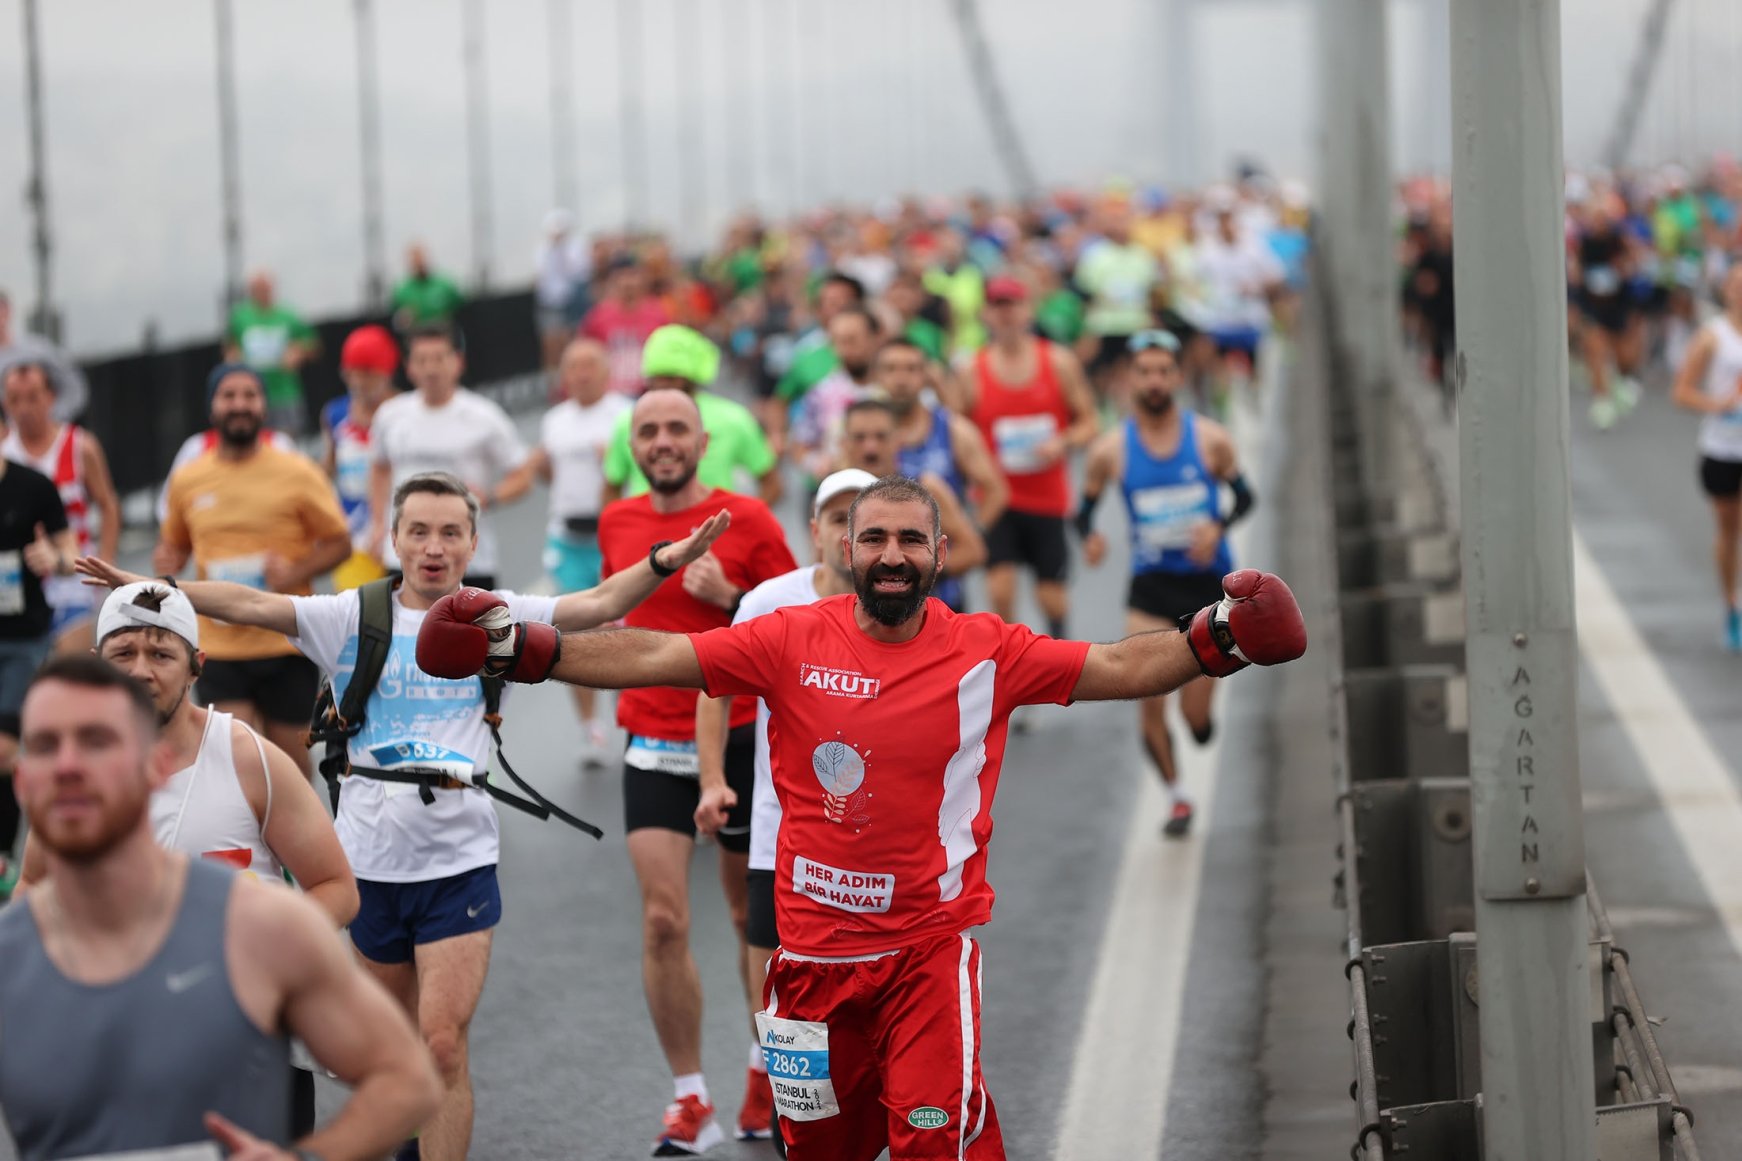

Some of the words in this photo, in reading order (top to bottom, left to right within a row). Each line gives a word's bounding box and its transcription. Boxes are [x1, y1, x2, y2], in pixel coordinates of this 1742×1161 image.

[804, 670, 876, 695] AKUT
[805, 863, 833, 883] HER
[838, 873, 886, 890] ADIM
[829, 890, 885, 908] HAYAT
[772, 1051, 811, 1077] 2862
[911, 1111, 944, 1119] GREEN
